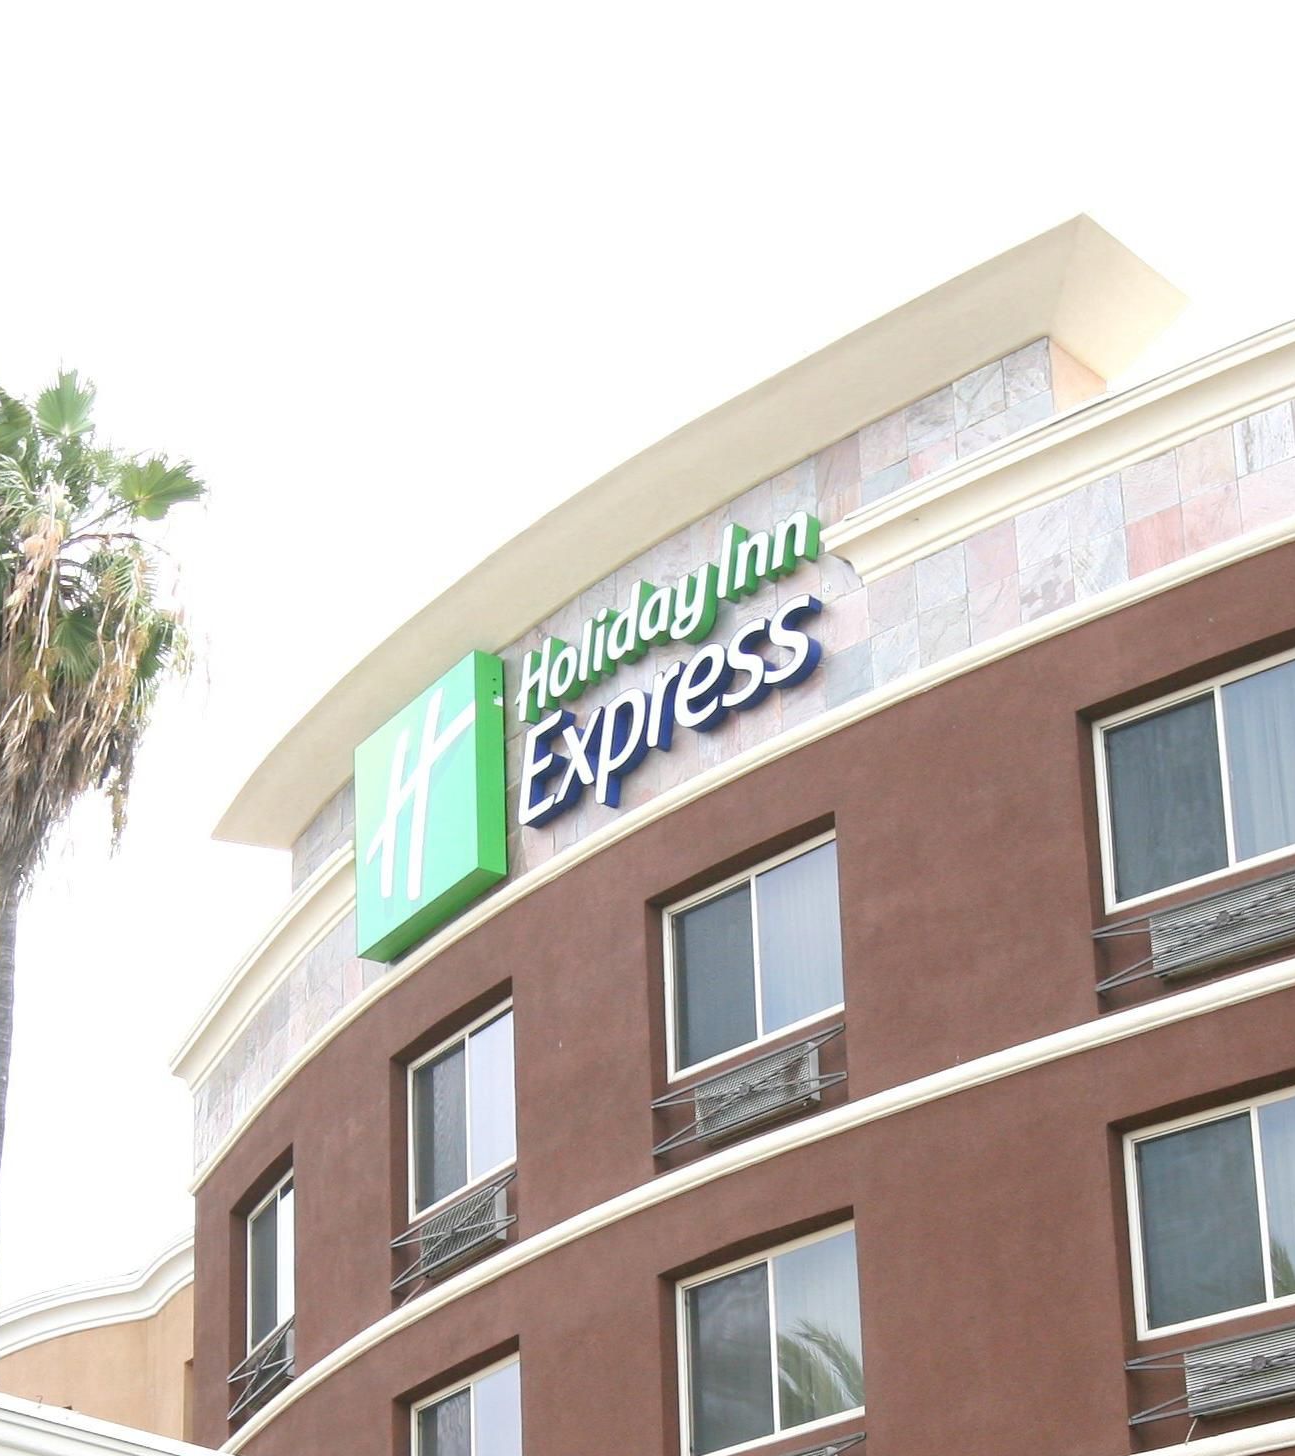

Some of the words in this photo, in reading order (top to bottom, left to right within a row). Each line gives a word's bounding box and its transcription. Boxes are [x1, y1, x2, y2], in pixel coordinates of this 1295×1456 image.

[514, 562, 719, 723] Holiday
[716, 510, 820, 601] Inn
[518, 593, 822, 829] Express
